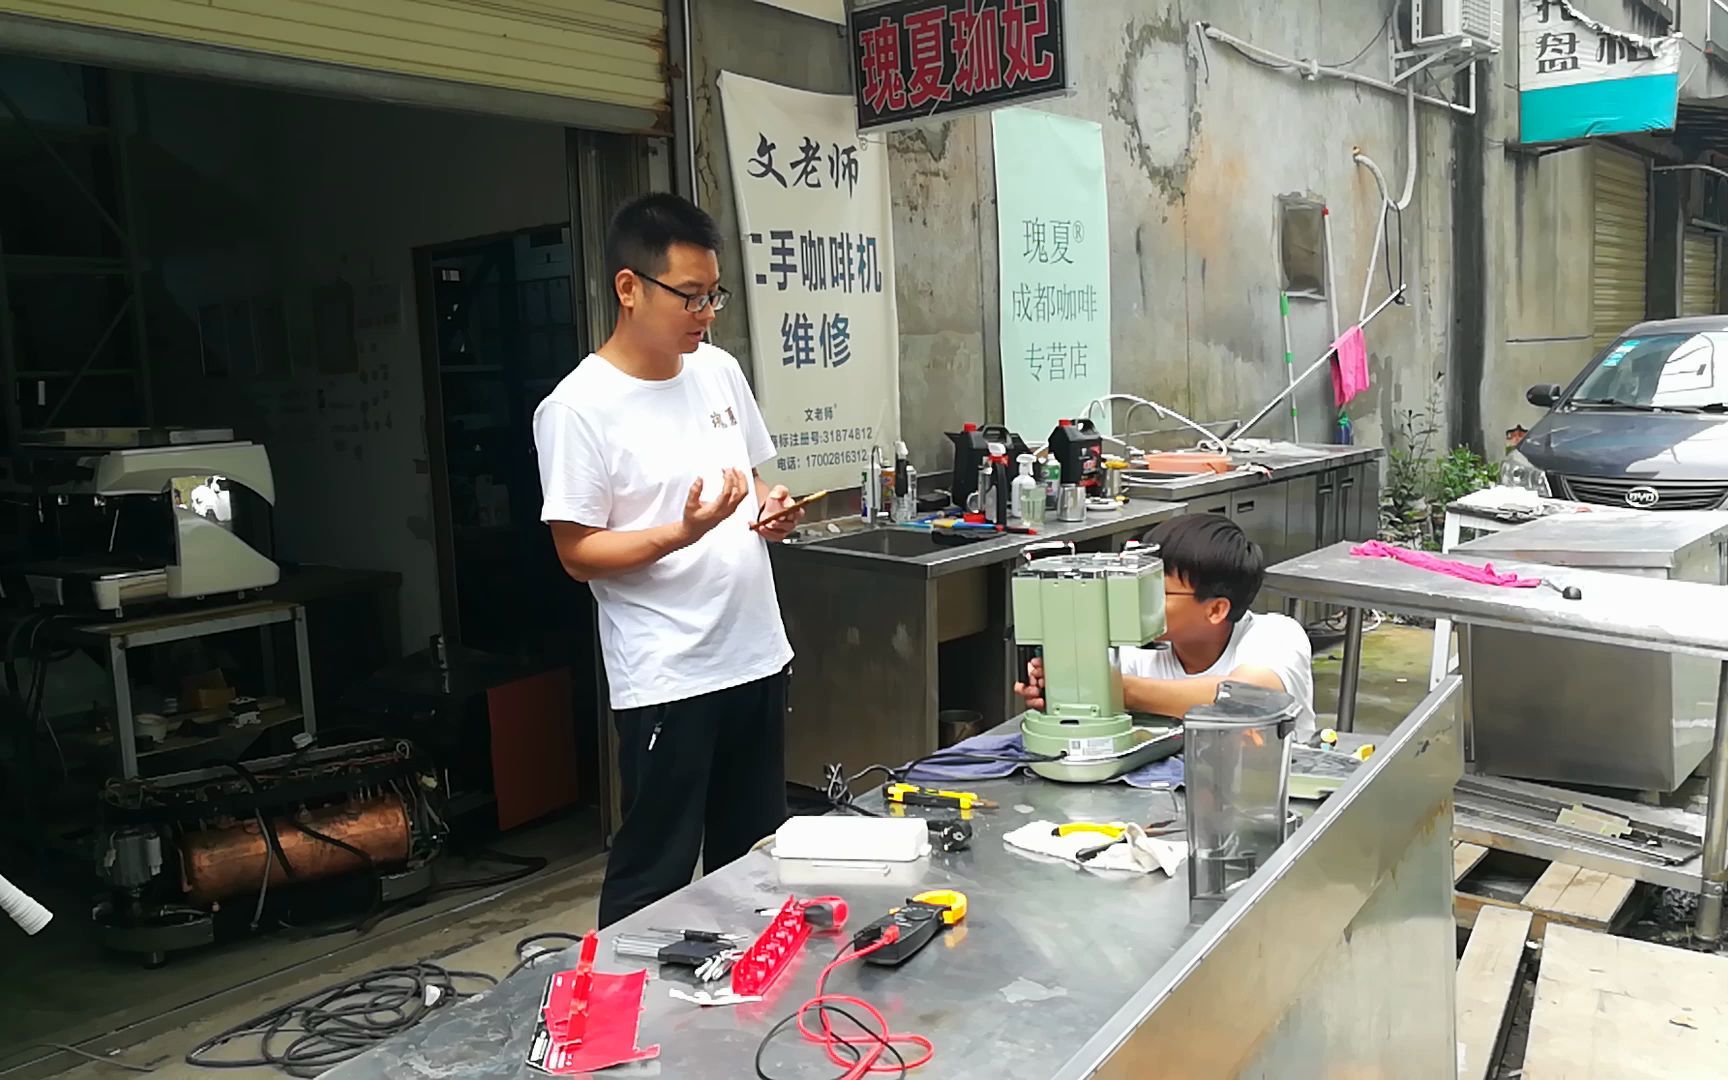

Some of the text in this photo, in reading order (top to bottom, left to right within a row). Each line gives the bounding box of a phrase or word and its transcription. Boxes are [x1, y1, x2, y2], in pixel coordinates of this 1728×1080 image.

[858, 0, 1054, 114] 瑰夏珈妃
[747, 132, 859, 199] 文老师
[1012, 282, 1098, 323] 成都咖啡
[781, 312, 851, 369] 维修
[1024, 341, 1088, 382] 专营店
